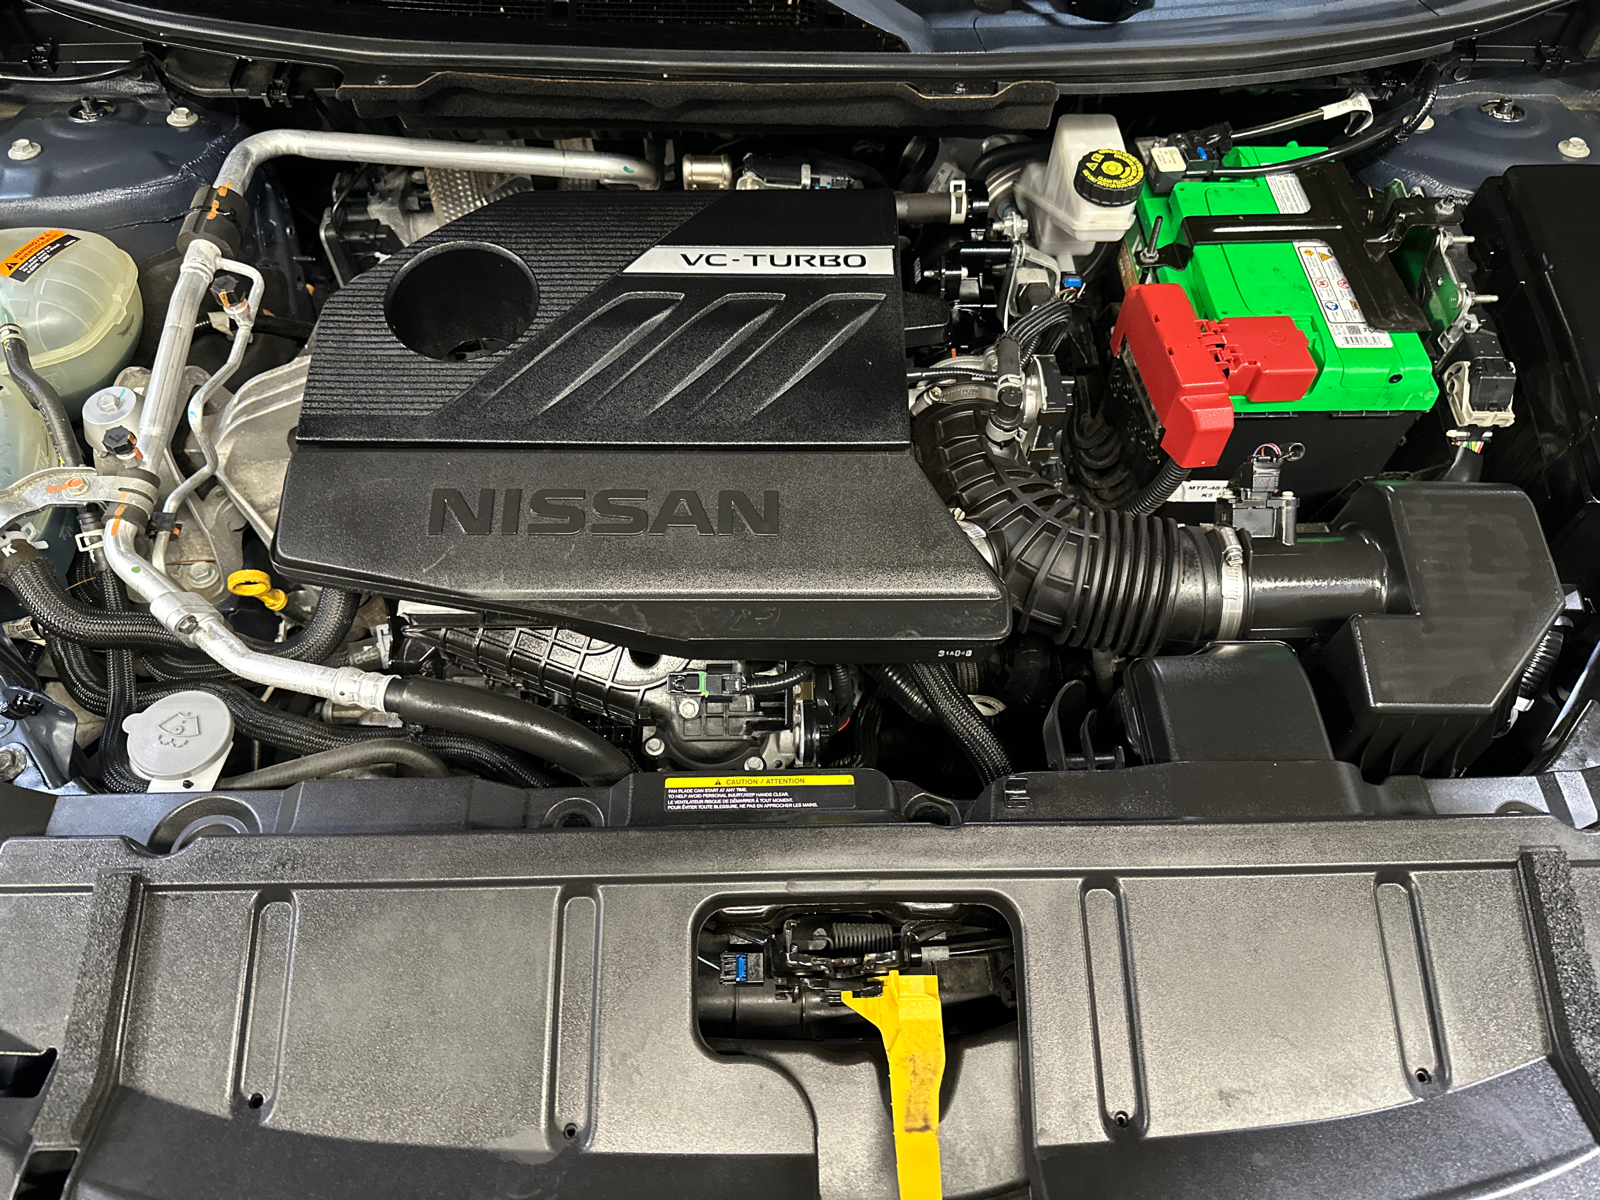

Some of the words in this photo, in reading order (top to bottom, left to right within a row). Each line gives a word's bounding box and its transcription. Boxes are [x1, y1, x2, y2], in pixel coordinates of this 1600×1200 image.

[680, 254, 867, 268] VC-TURBO
[427, 488, 780, 537] NISSAN
[726, 778, 758, 786] CAUTION
[766, 777, 805, 785] ATTENTION
